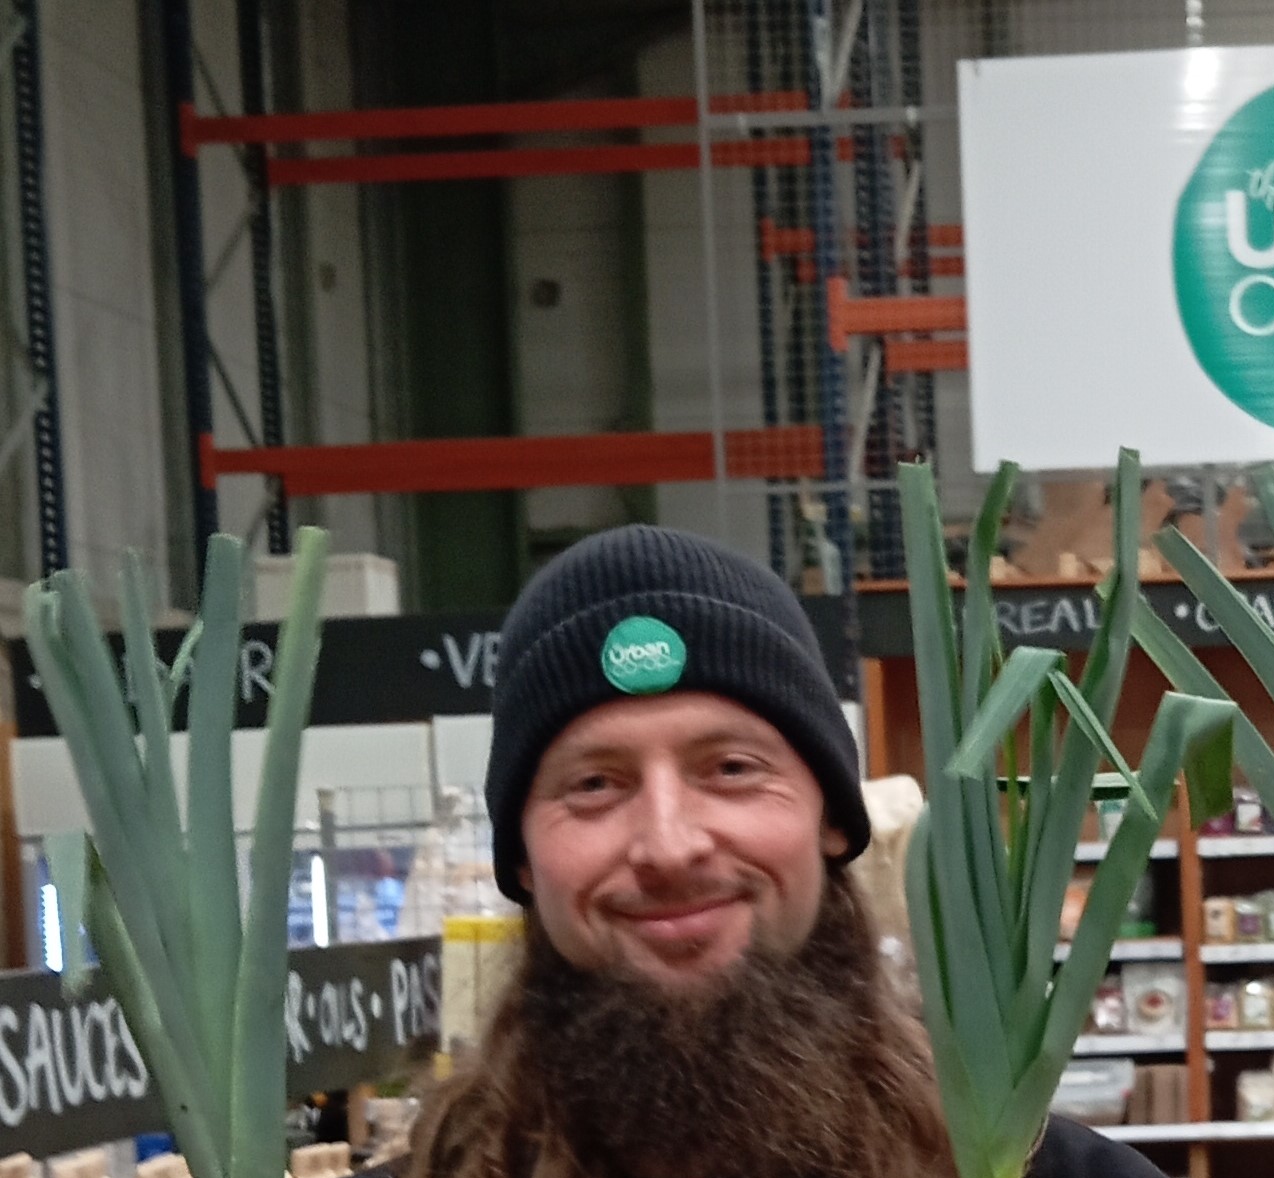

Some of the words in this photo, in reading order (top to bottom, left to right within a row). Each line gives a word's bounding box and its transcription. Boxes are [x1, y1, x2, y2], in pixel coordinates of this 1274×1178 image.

[996, 597, 1103, 634] REAL
[608, 641, 671, 665] Urban
[0, 995, 149, 1127] SAUCES
